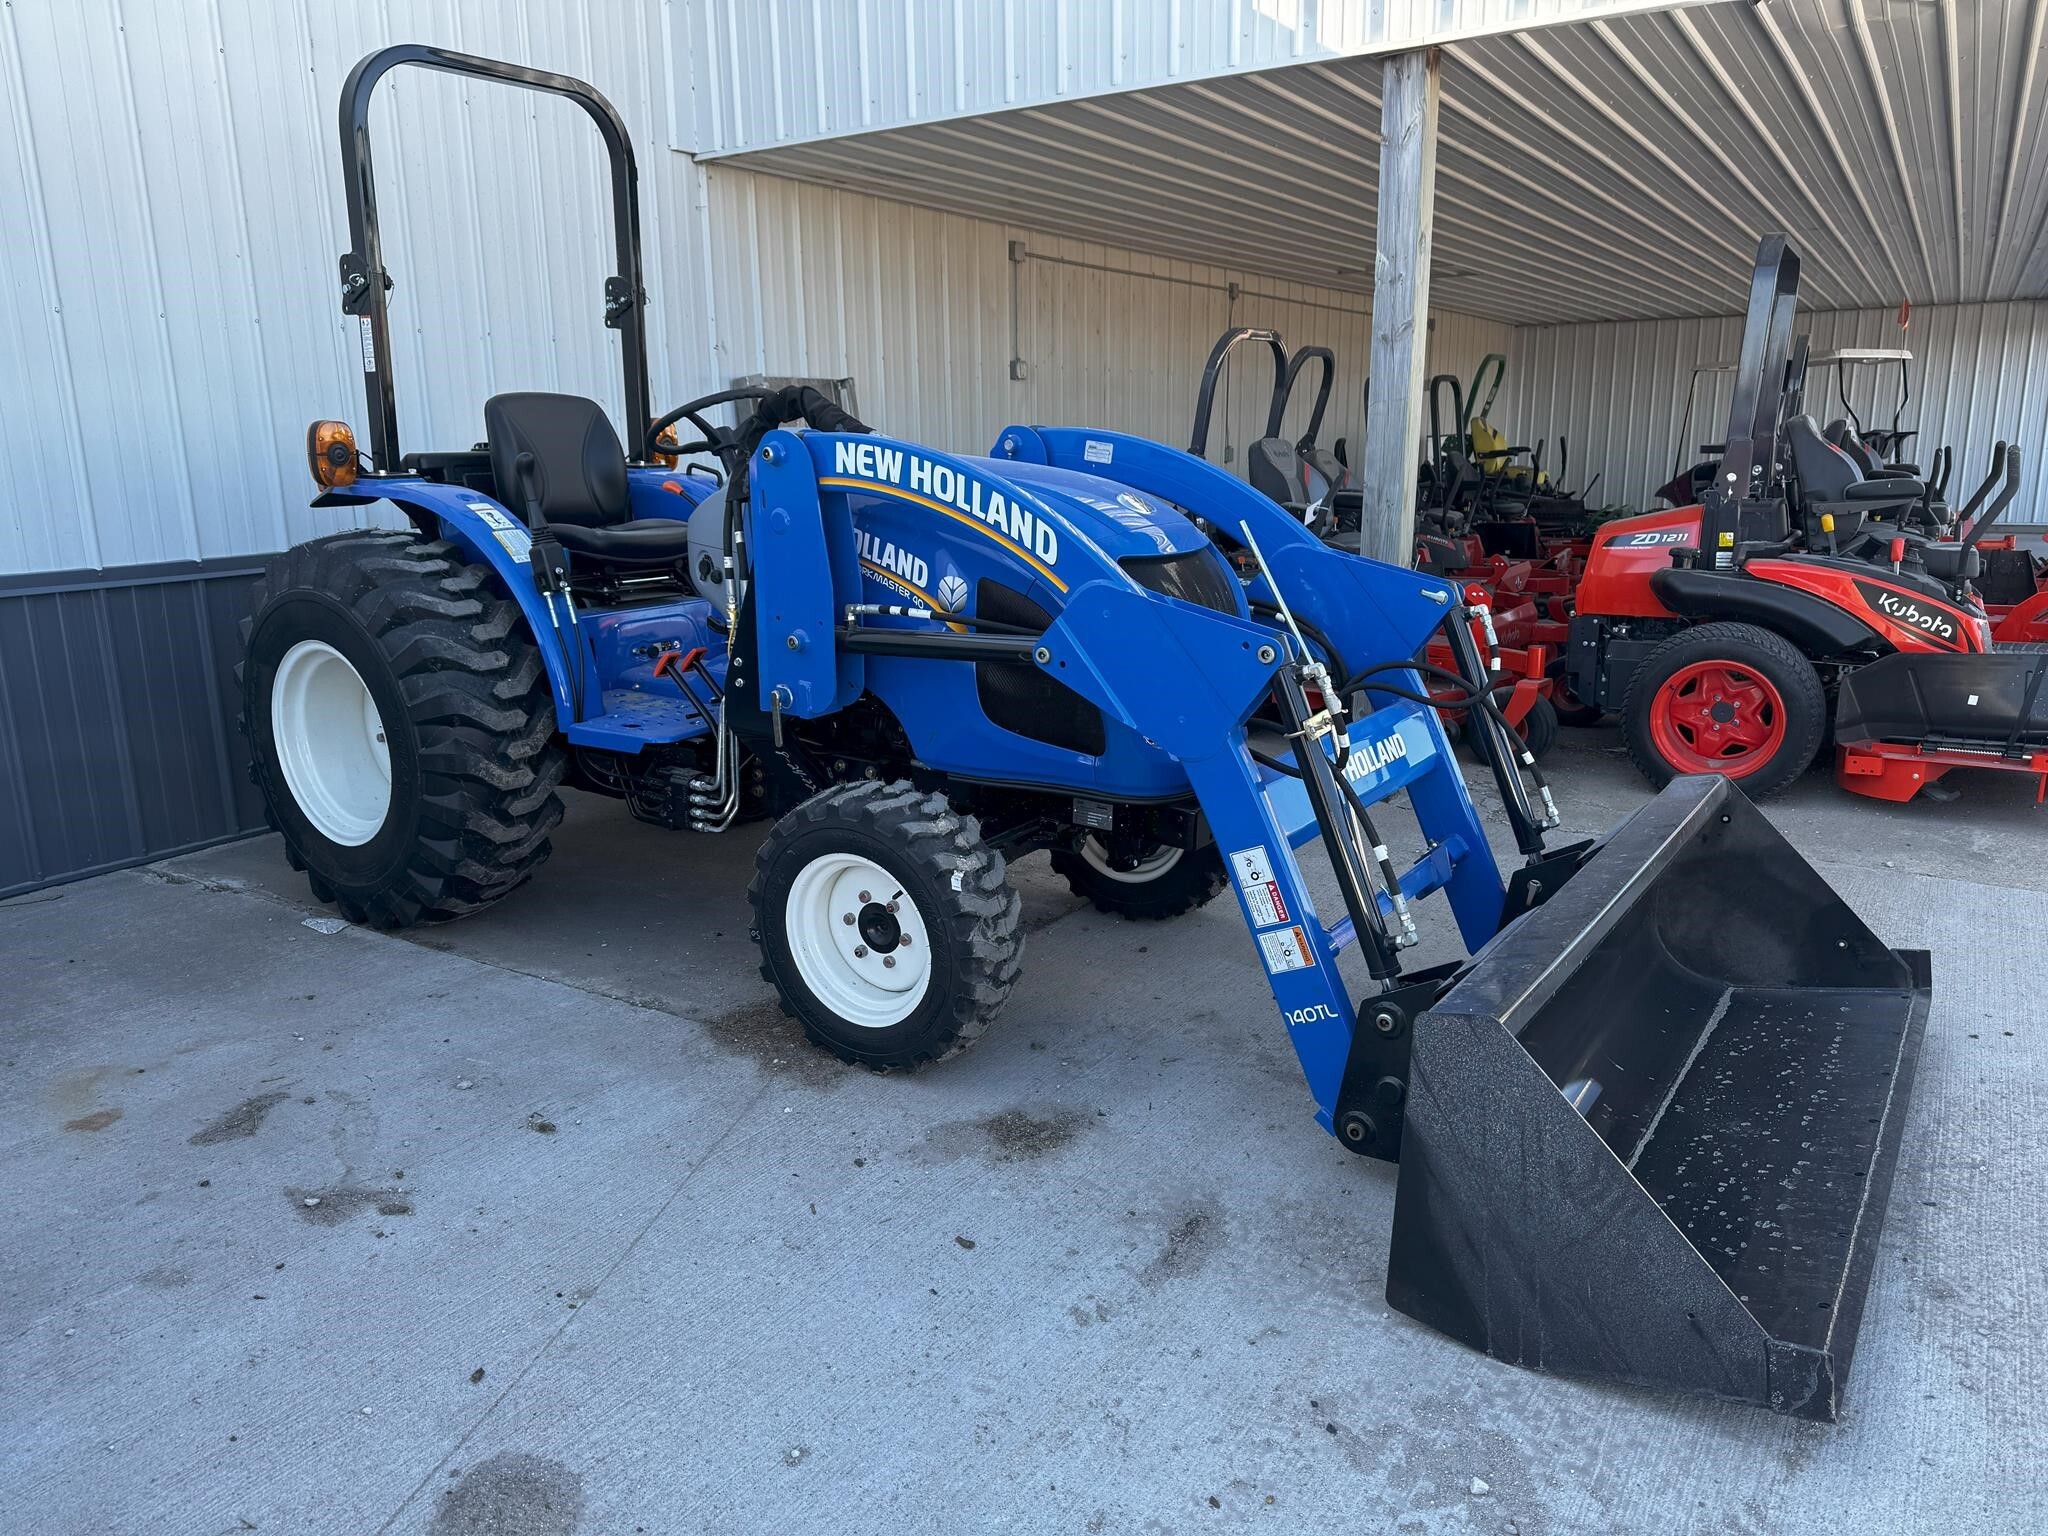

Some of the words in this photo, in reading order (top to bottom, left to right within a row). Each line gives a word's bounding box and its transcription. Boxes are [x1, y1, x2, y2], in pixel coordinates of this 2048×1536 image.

[835, 441, 903, 484] NEW
[910, 455, 1058, 566] HOLLAND
[1630, 533, 1660, 545] ZD
[912, 595, 924, 610] 40
[1878, 592, 1953, 638] Kubota
[1345, 732, 1407, 782] HOLLAND
[1271, 890, 1287, 920] DANGER
[1284, 1003, 1339, 1027] 140TL
